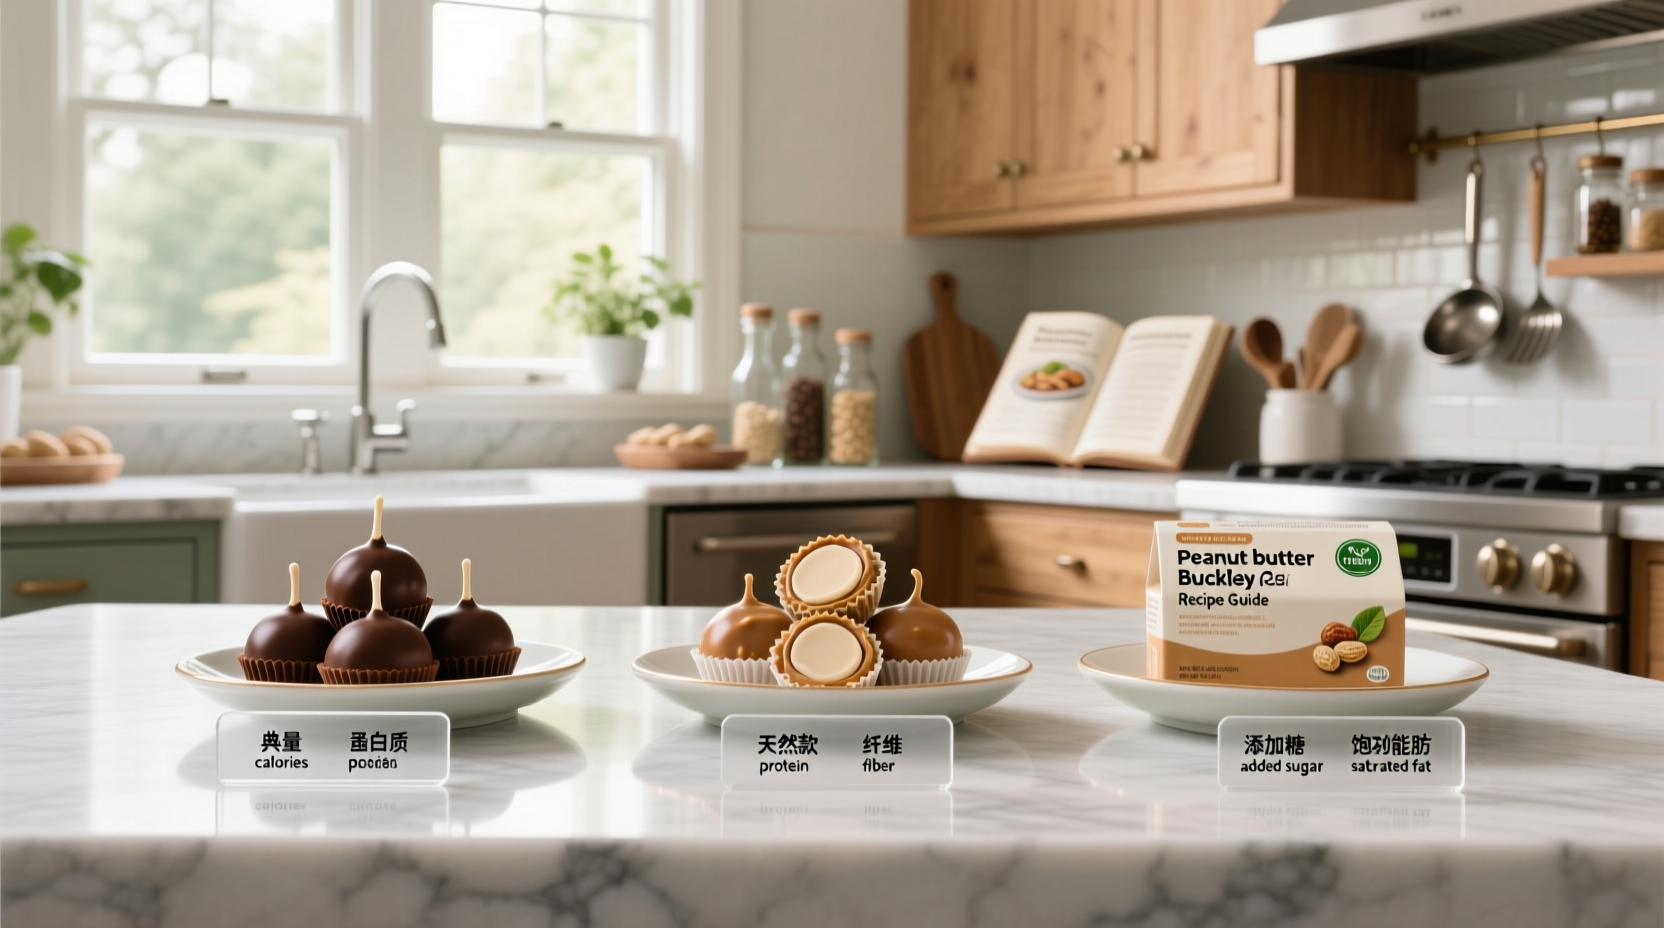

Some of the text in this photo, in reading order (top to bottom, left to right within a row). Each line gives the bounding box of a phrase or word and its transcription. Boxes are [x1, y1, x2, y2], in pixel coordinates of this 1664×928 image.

[1177, 548, 1315, 567] Peanut butter
[1177, 568, 1255, 591] Buckley
[1178, 592, 1270, 610] Recipe Guide
[862, 733, 903, 755] 纤维
[1244, 733, 1306, 756] 添加糖
[254, 755, 309, 769] calories
[759, 759, 809, 776] protein
[1240, 758, 1282, 773] added
[1285, 761, 1324, 777] sugar
[1411, 758, 1432, 773] fat
